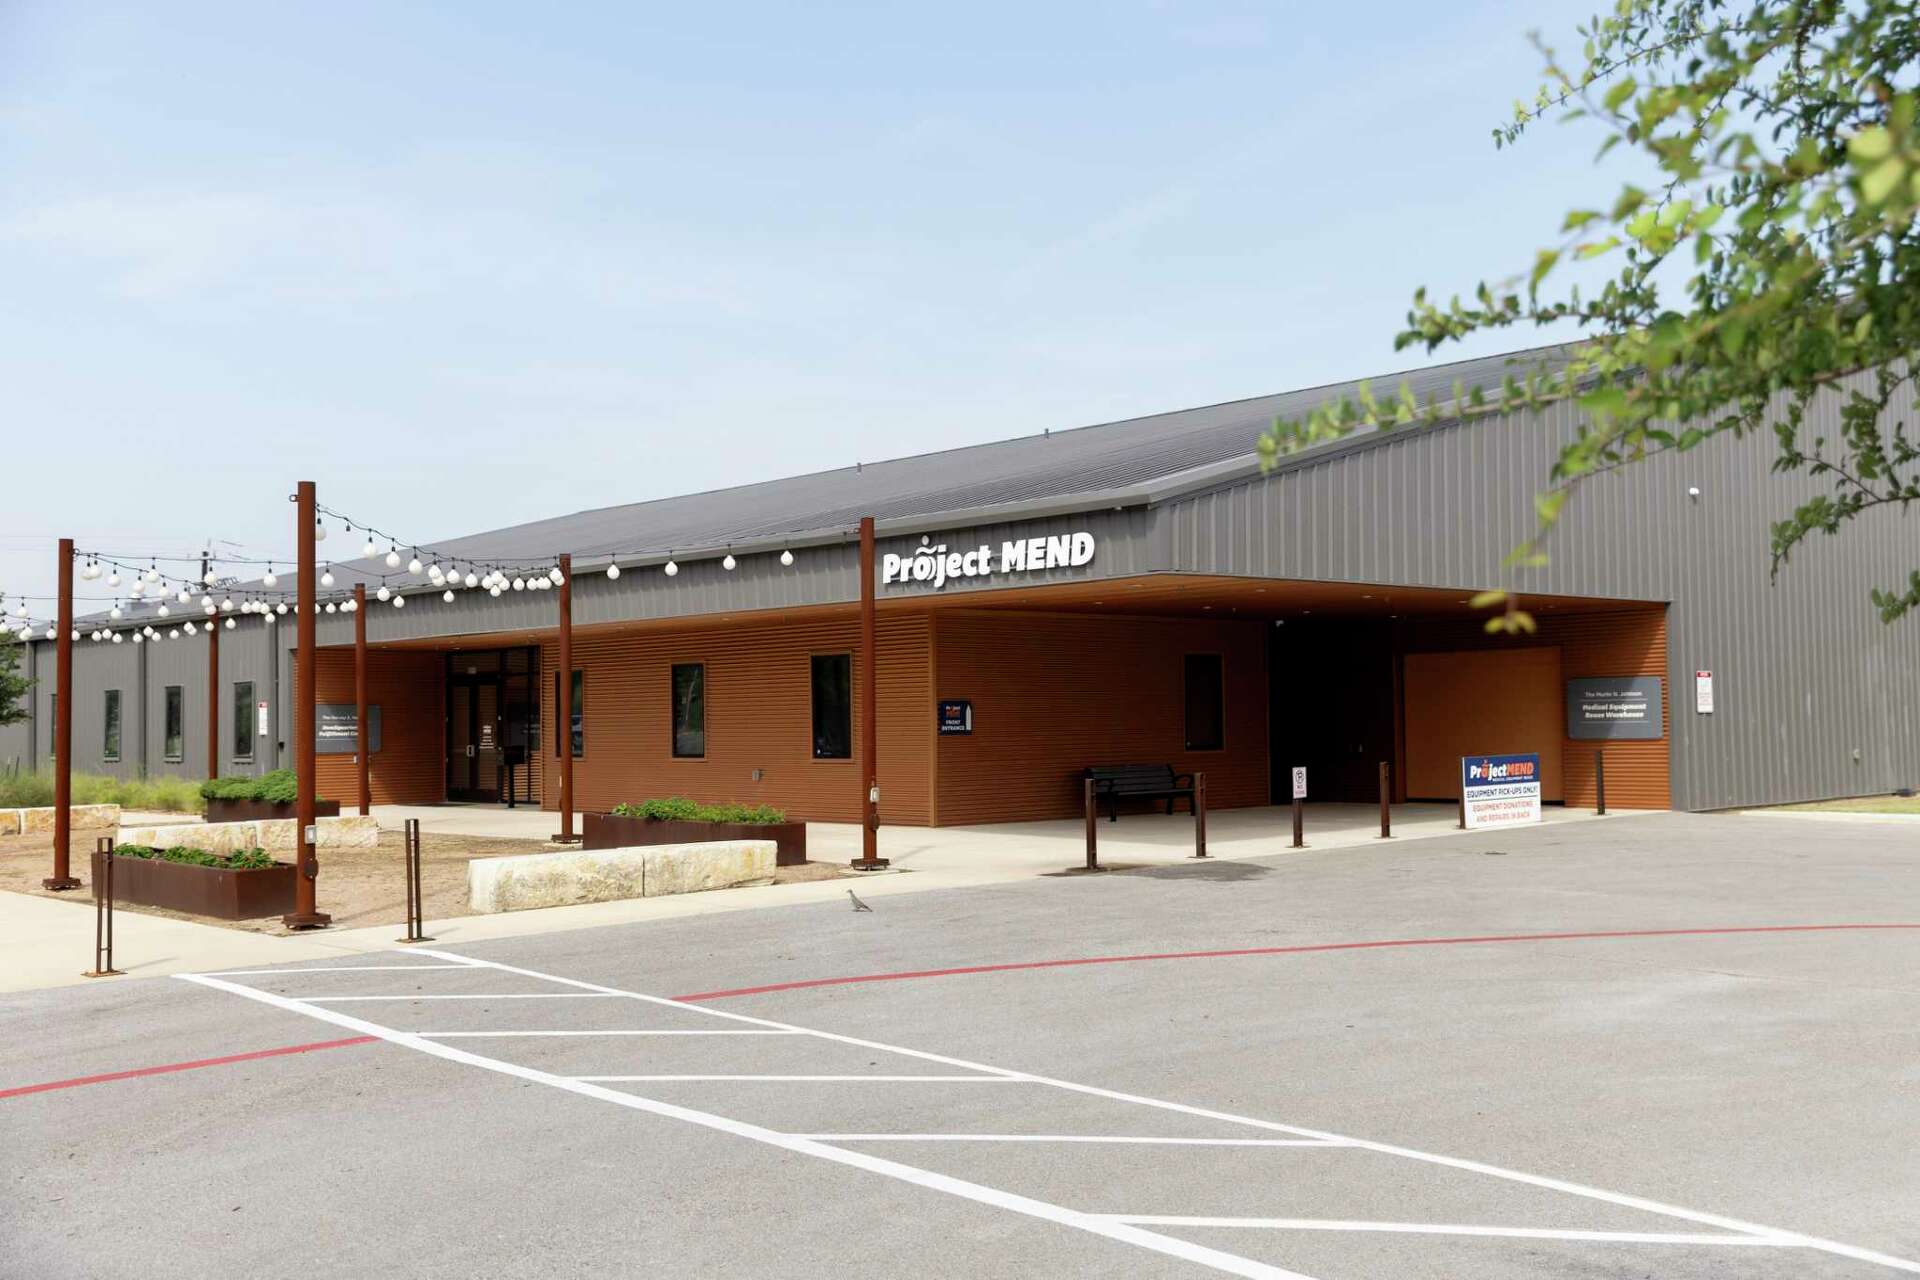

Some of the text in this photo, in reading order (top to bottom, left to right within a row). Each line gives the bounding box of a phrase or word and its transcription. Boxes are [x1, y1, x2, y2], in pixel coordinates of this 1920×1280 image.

[882, 532, 1095, 588] Project MEND
[1609, 703, 1647, 711] Equipment
[1466, 788, 1497, 798] EQUIPMENT
[1473, 801, 1533, 811] EQUIPMENT DONATIONS
